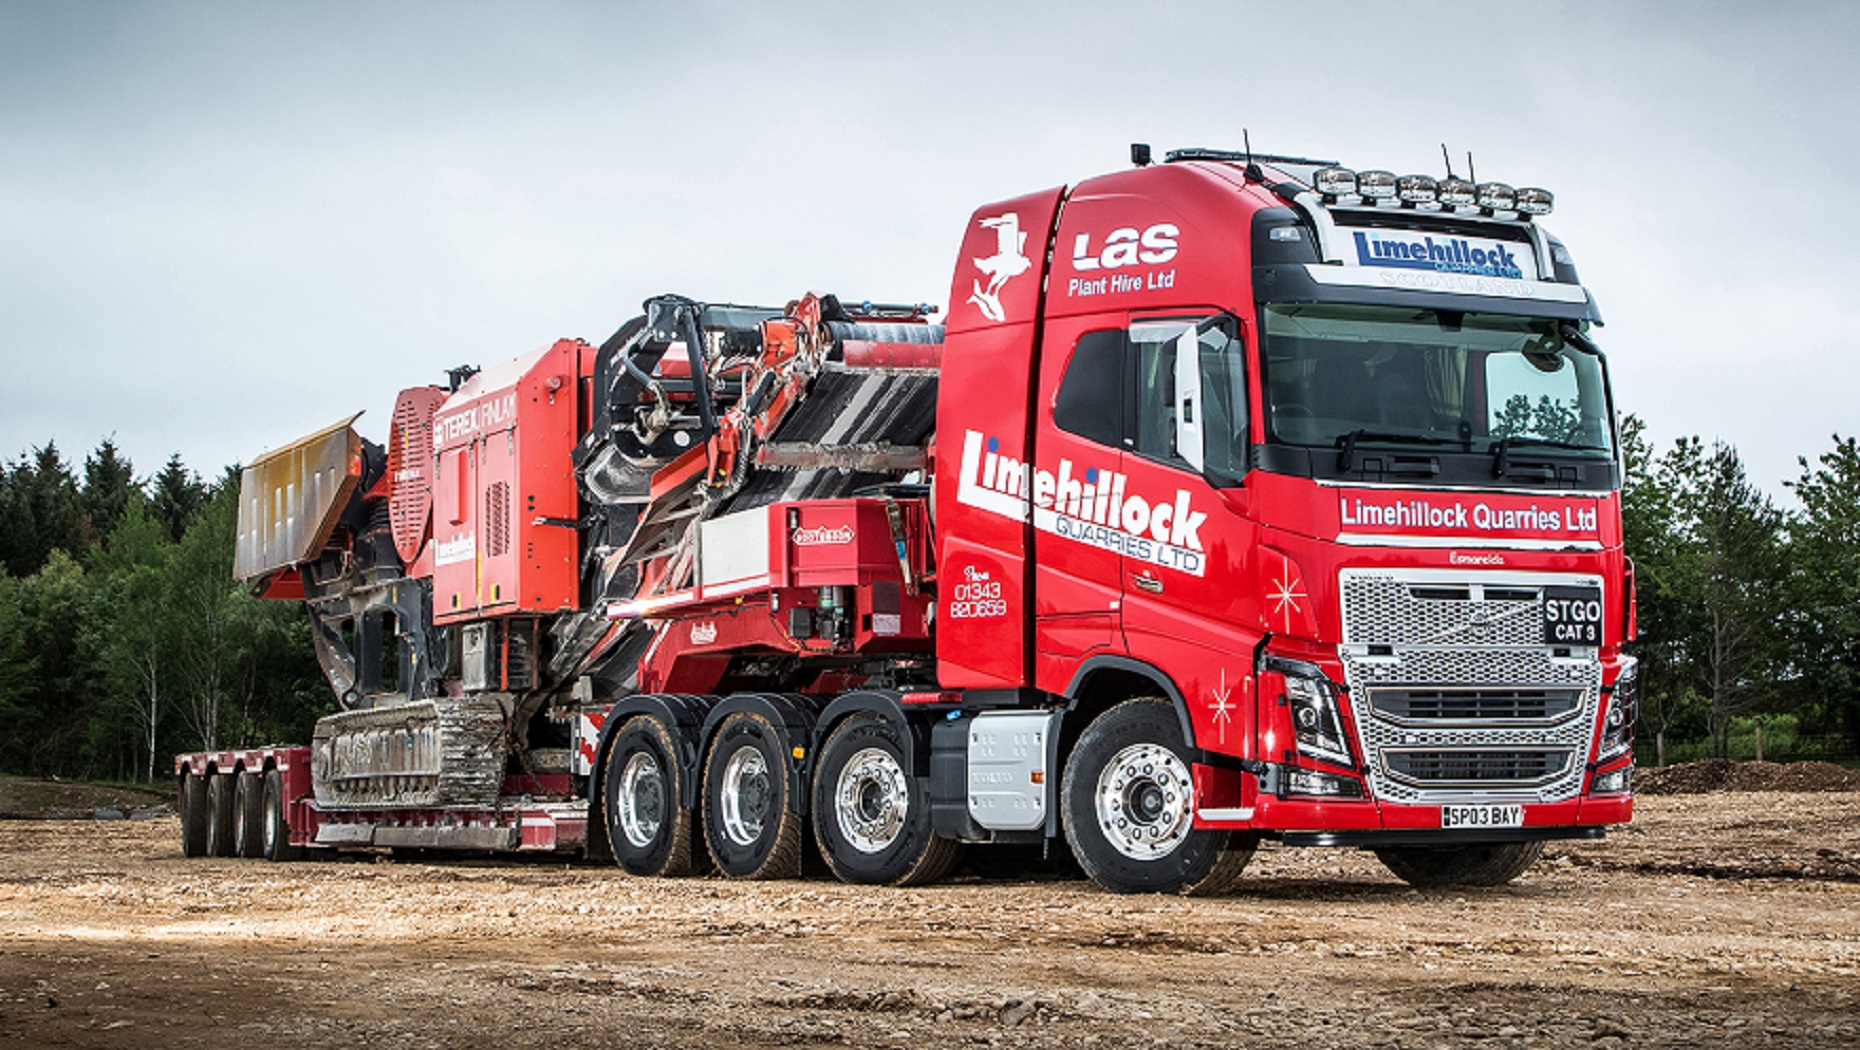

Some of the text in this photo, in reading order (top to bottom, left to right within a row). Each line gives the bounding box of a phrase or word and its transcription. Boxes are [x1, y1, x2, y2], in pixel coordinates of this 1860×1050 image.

[1353, 231, 1519, 271] Limehillock
[1067, 267, 1176, 297] Plant Hire Ltd
[957, 428, 1208, 552] Limehillock
[1341, 498, 1597, 532] Limehillock Quarries Ltd
[1055, 515, 1200, 572] QUARRIES LTD
[954, 582, 1001, 601] 01343
[1546, 599, 1601, 622] STGO
[1555, 624, 1596, 640] CAT 3
[1451, 806, 1519, 825] SP03 BAY
